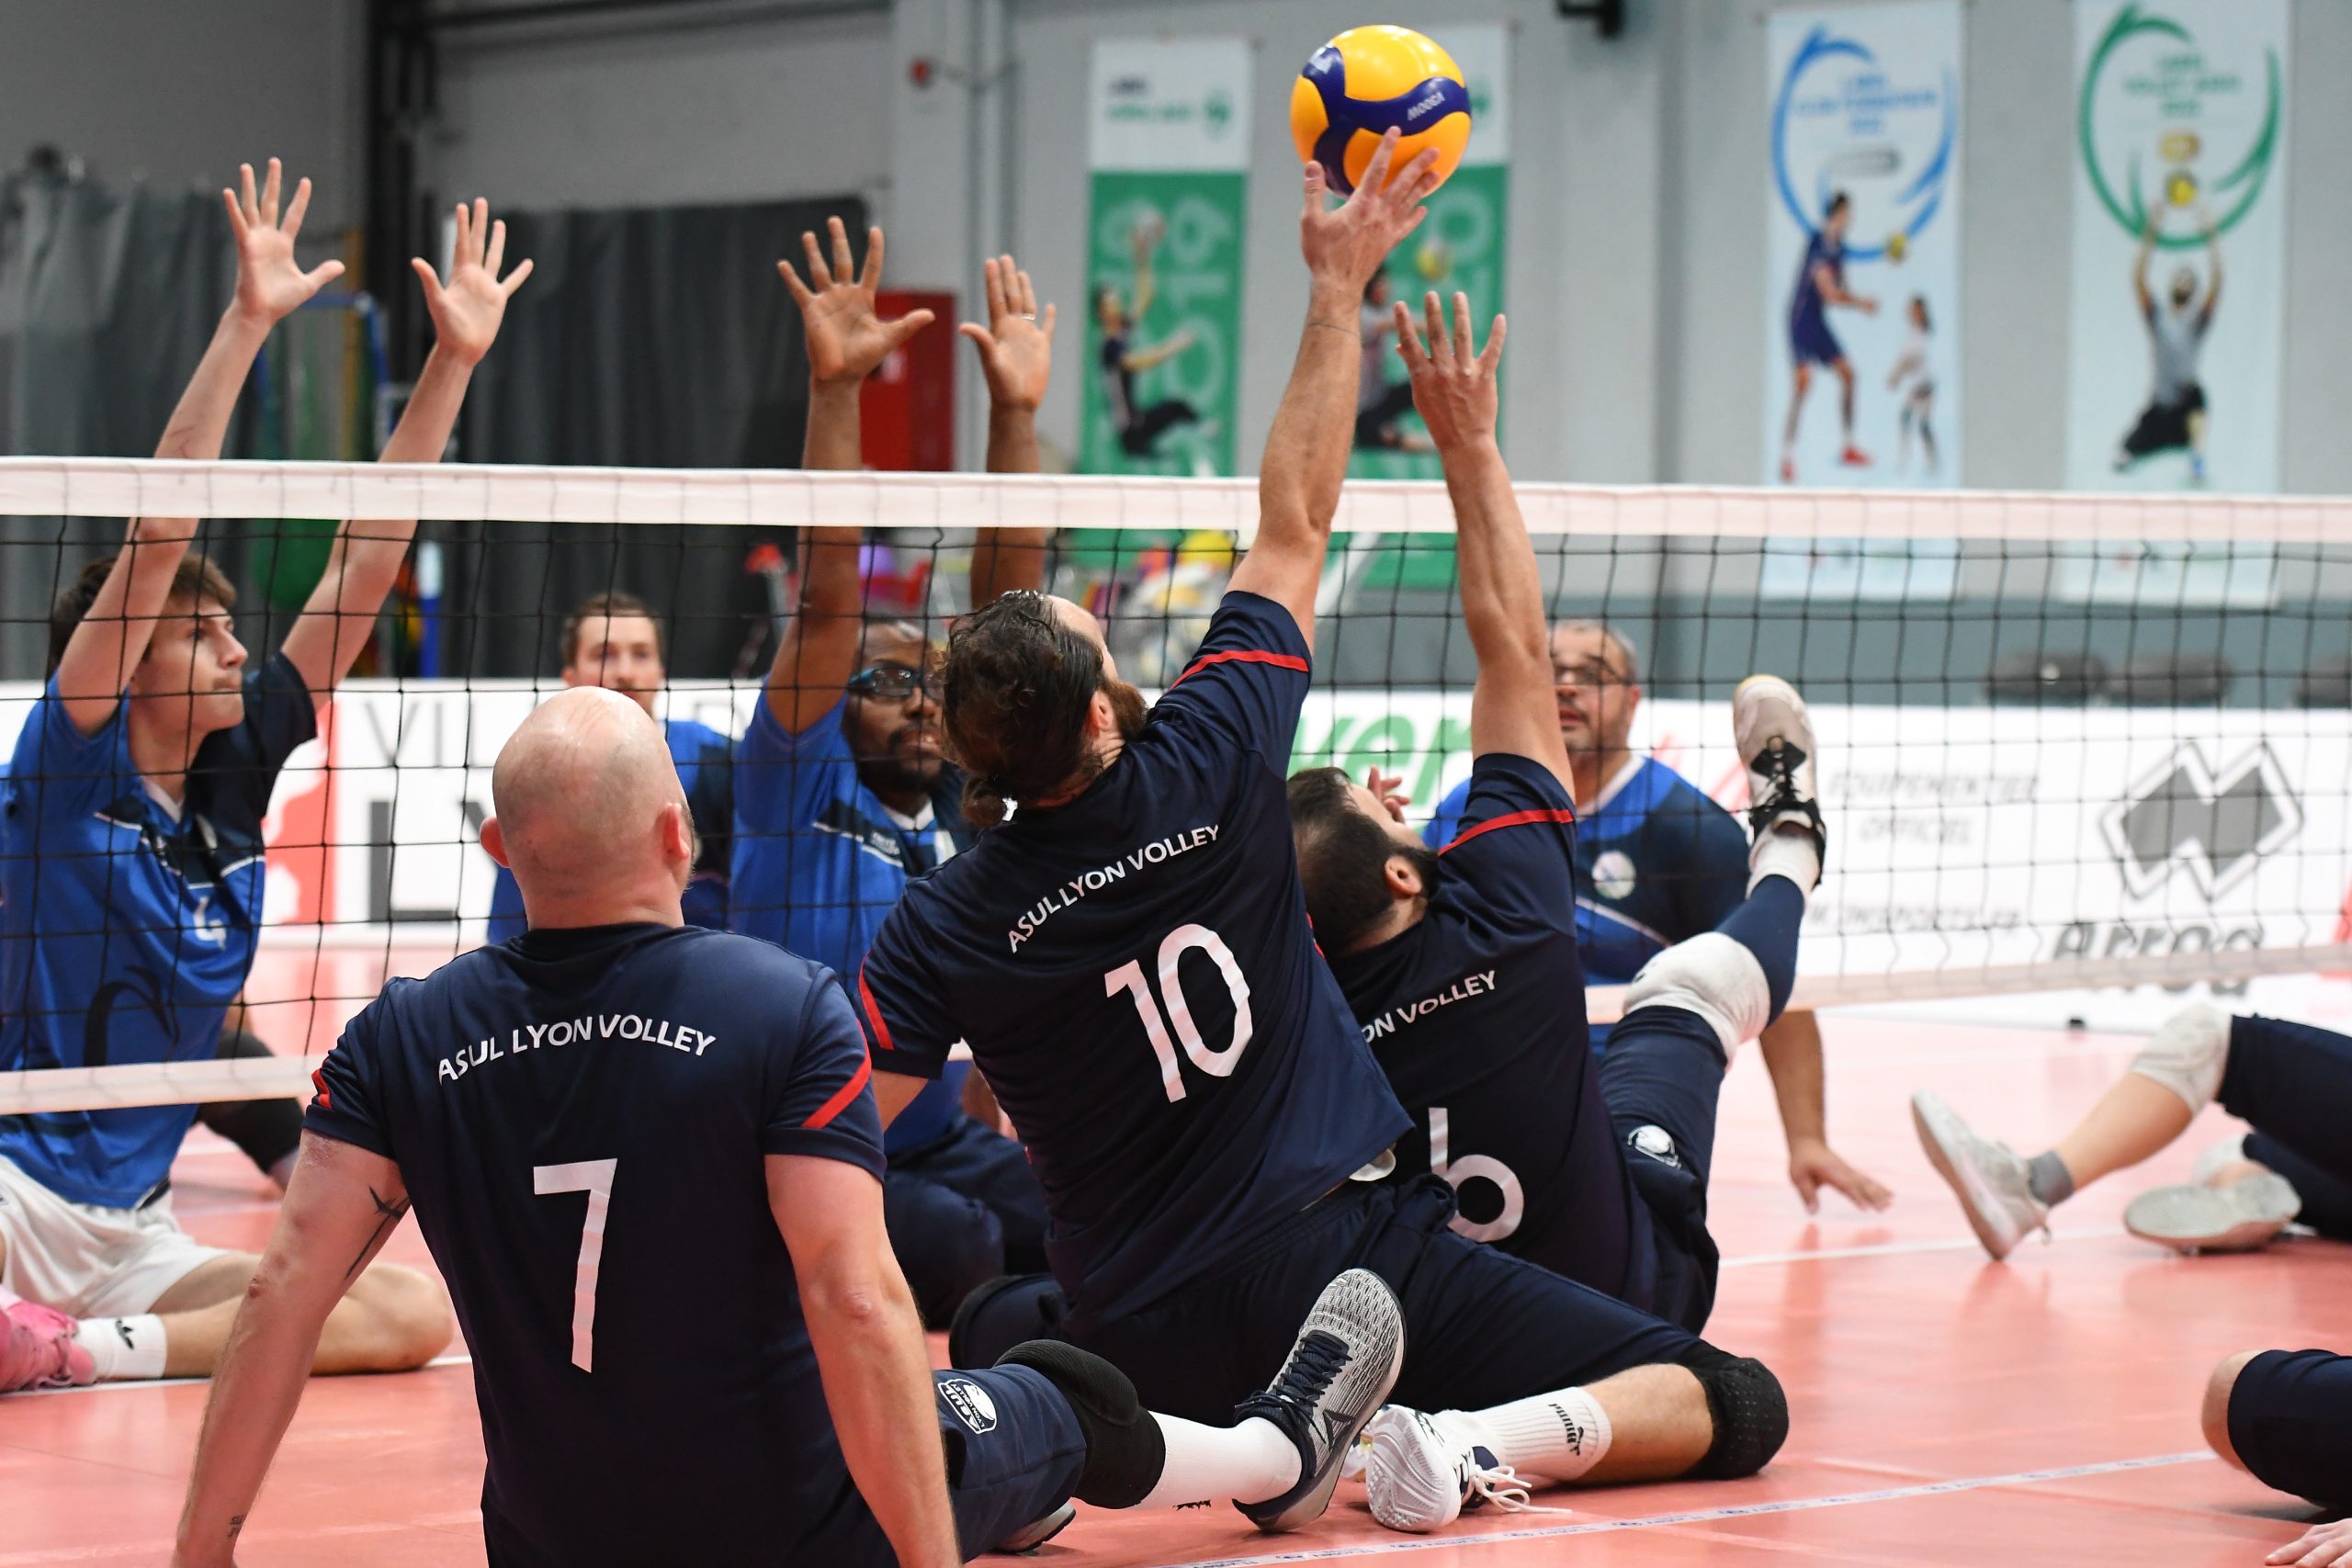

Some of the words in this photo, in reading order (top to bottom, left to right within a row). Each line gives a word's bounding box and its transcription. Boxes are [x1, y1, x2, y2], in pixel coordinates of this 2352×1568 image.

[365, 700, 492, 770] VIL
[1008, 897, 1062, 953] ASUL
[1058, 861, 1126, 907] LYON
[1126, 824, 1219, 871] VOLLEY
[438, 1036, 504, 1084] ASUL
[512, 1016, 593, 1054] LYON
[599, 1013, 717, 1056] VOLLEY
[1104, 923, 1253, 1103] 10
[1396, 970, 1496, 1024] VOLLEY
[1429, 1107, 1524, 1242] 6
[533, 1157, 618, 1373] 7
